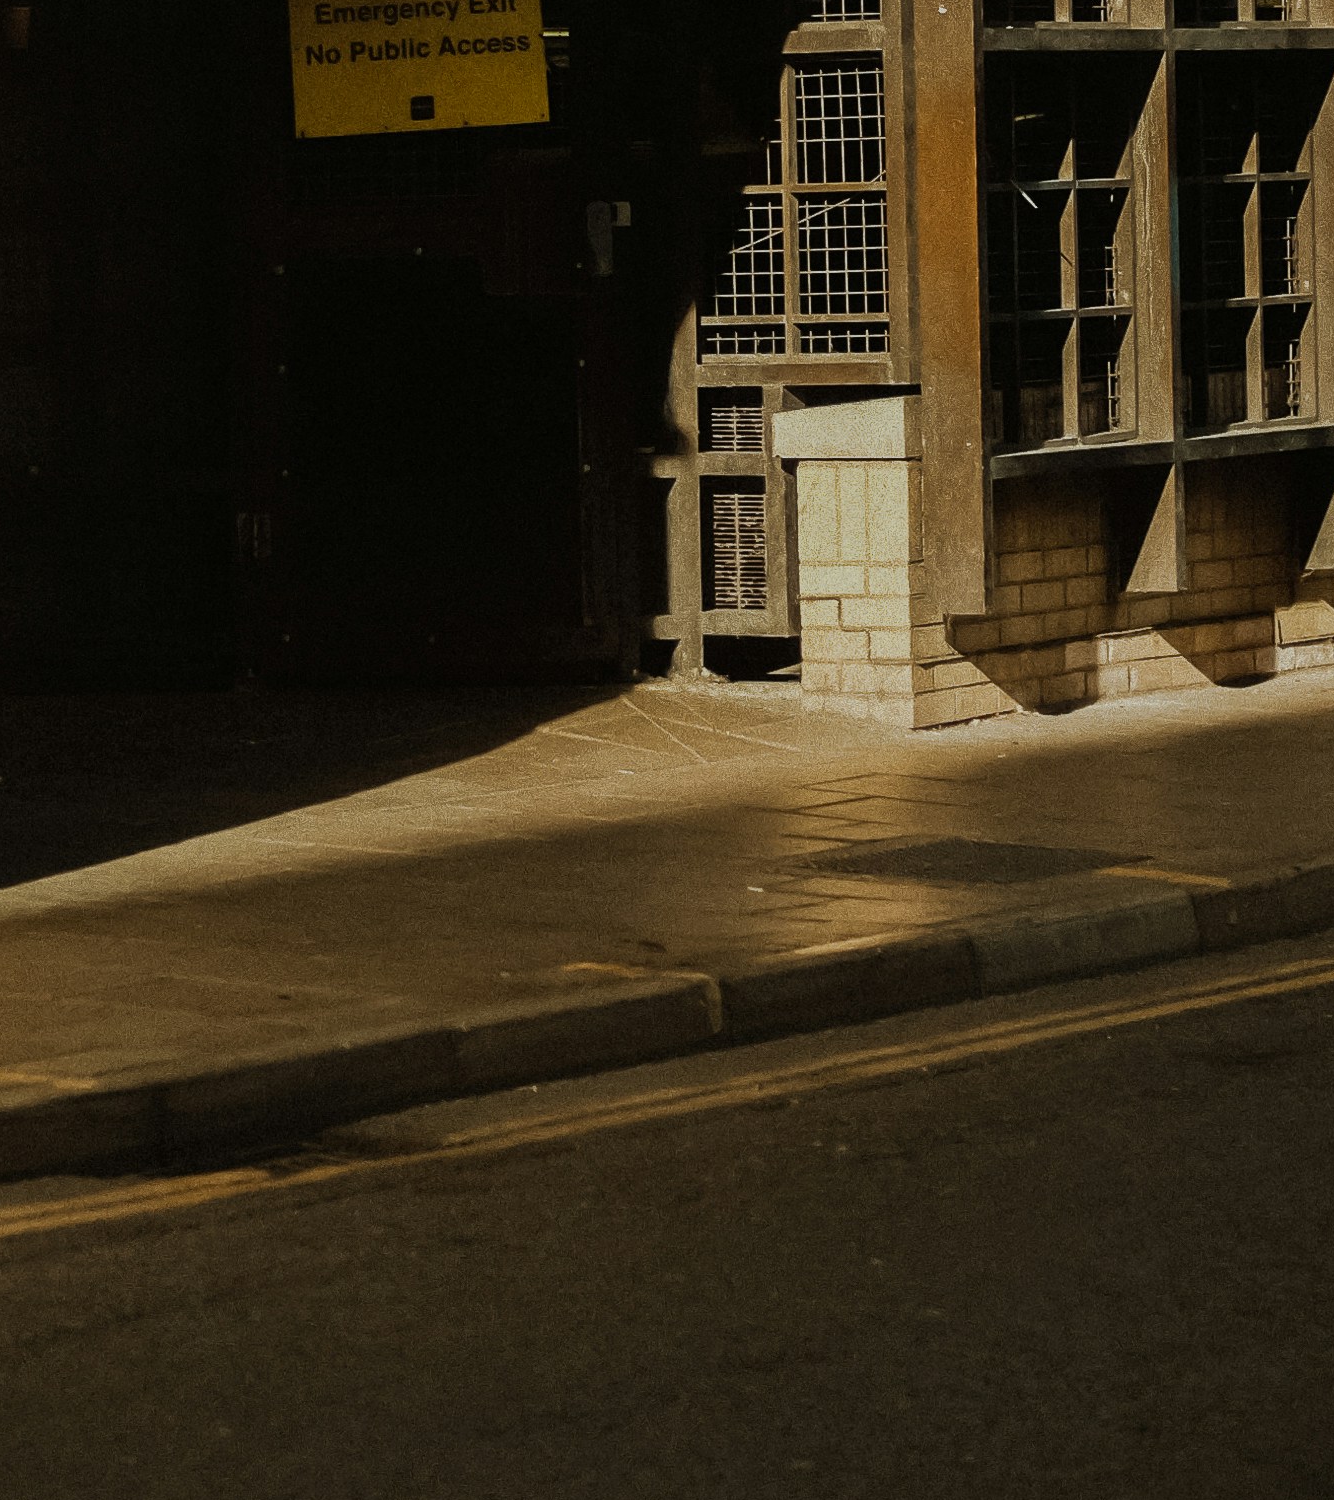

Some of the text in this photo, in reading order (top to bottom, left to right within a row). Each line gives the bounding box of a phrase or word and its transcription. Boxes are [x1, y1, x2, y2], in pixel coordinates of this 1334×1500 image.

[305, 33, 531, 65] No Public Access
